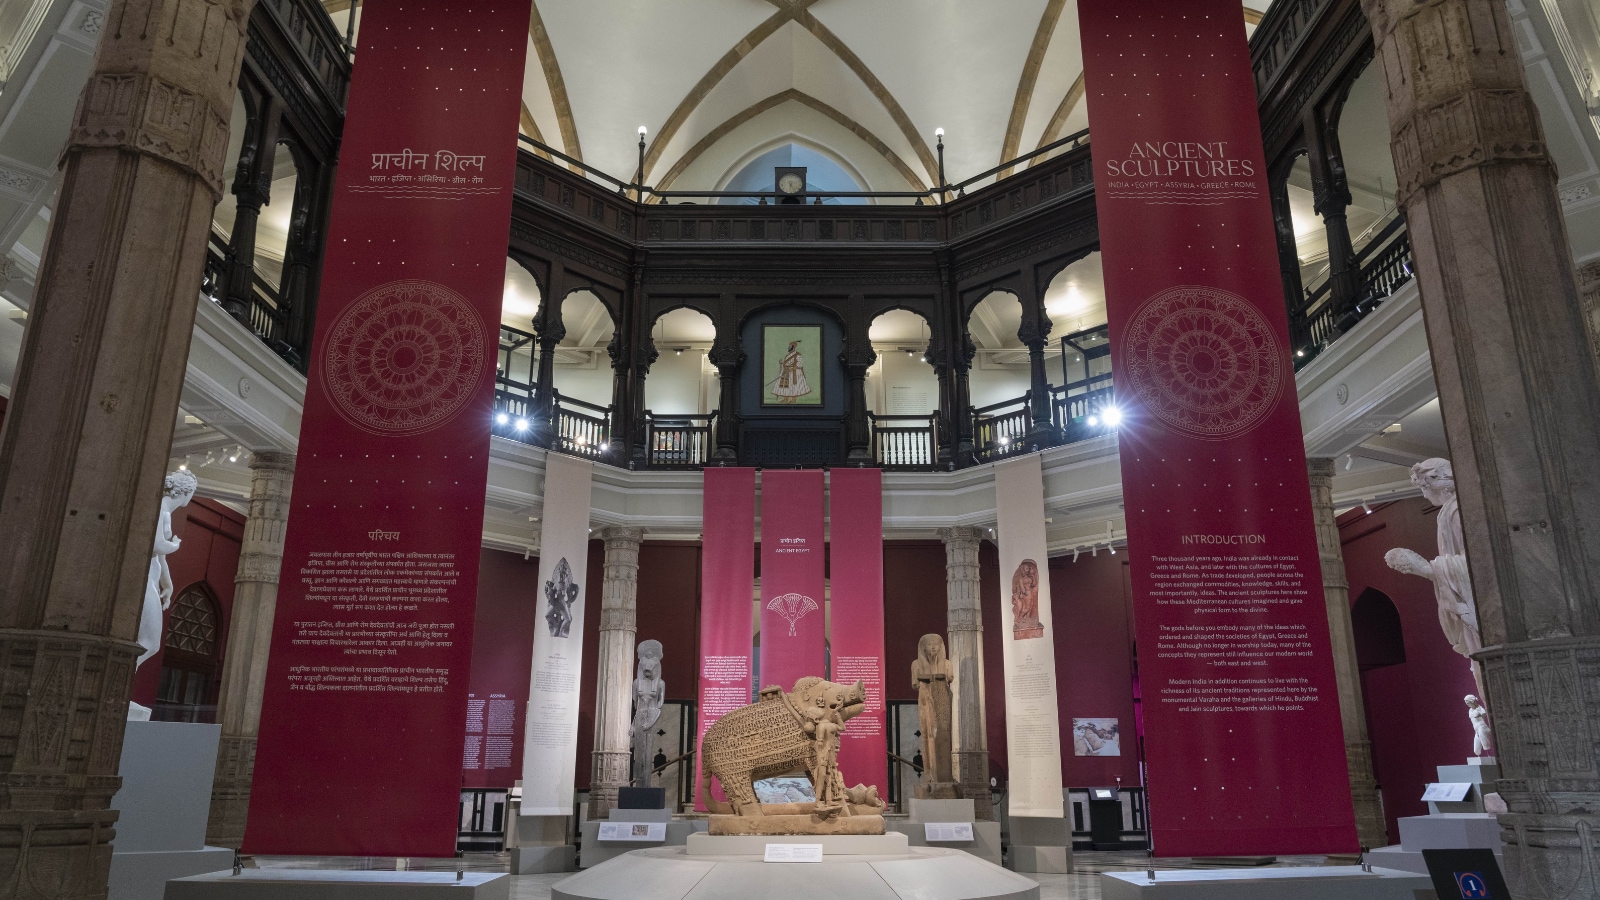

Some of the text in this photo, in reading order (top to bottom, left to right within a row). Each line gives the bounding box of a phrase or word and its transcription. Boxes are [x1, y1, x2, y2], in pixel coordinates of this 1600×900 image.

[1129, 142, 1228, 159] ANCIENT
[370, 148, 486, 171] प्राचीन शिल्प
[1106, 160, 1255, 177] SCULPTURES
[471, 176, 484, 184] रोम
[368, 529, 400, 541] परिचय
[1182, 534, 1266, 545] INTRODUCTION
[1154, 581, 1173, 589] region
[1216, 624, 1239, 632] embody
[1193, 633, 1215, 641] shaped
[1176, 642, 1203, 650] Although
[1157, 651, 1183, 659] concepts
[1251, 686, 1286, 694] represented
[1468, 880, 1477, 891] 1
